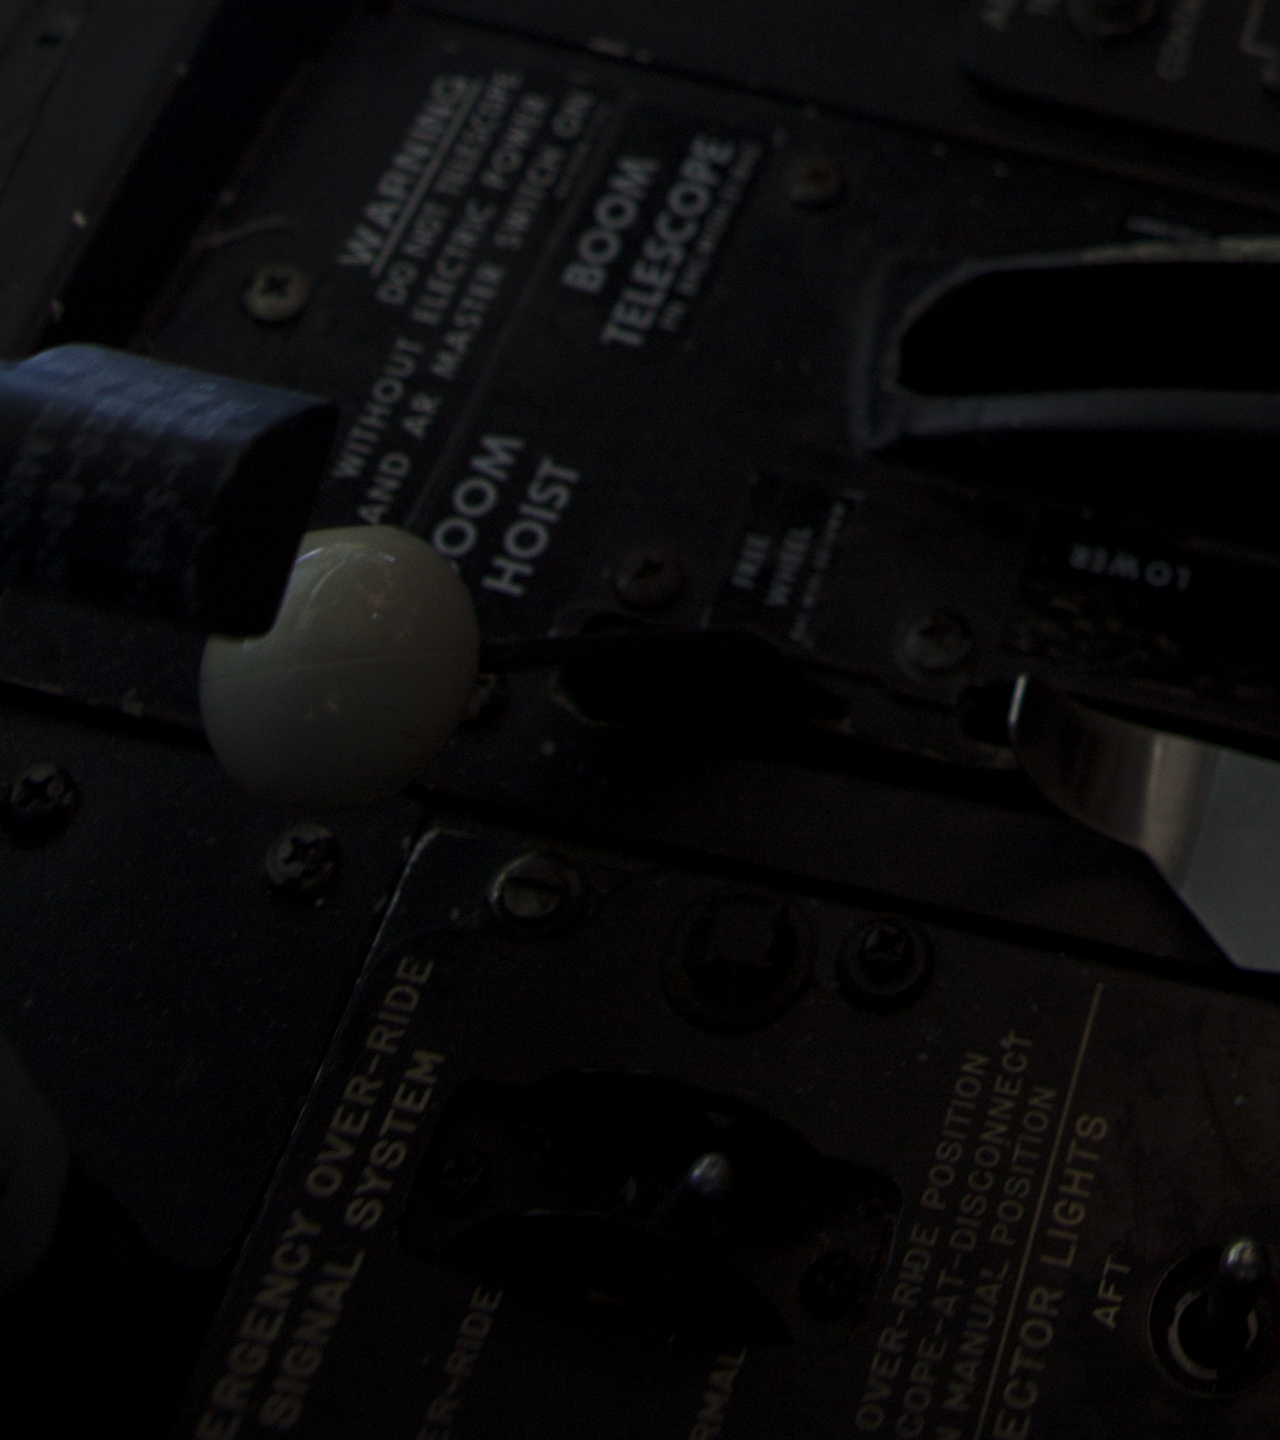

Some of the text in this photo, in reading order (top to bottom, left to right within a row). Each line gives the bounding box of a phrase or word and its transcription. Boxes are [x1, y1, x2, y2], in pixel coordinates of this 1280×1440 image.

[335, 73, 470, 268] WARNING
[374, 69, 525, 307] DO NOT TELESCOPE
[560, 153, 663, 297] BOOM
[598, 132, 740, 349] TELESCOPE
[330, 93, 551, 481] WITHOUT ELECTRIC POWER
[356, 449, 412, 527] AND
[401, 390, 446, 442] AR
[428, 261, 508, 380] MASTER
[492, 143, 566, 253] SWITCH
[550, 89, 595, 141] ON
[429, 431, 528, 573] OOM
[479, 455, 583, 598] HOIST
[1066, 538, 1195, 594] LOWER
[196, 954, 435, 1440] ERGENCY OVER-RIDE
[259, 1048, 446, 1430] SIGNAL SYSTEM
[855, 1050, 989, 1432] OVER-RIDE POSITION
[942, 1259, 1011, 1413] MANUAL
[989, 1083, 1059, 1248] POSITION
[1040, 1112, 1109, 1270] LIGHTS
[1091, 1254, 1133, 1331] AFT
